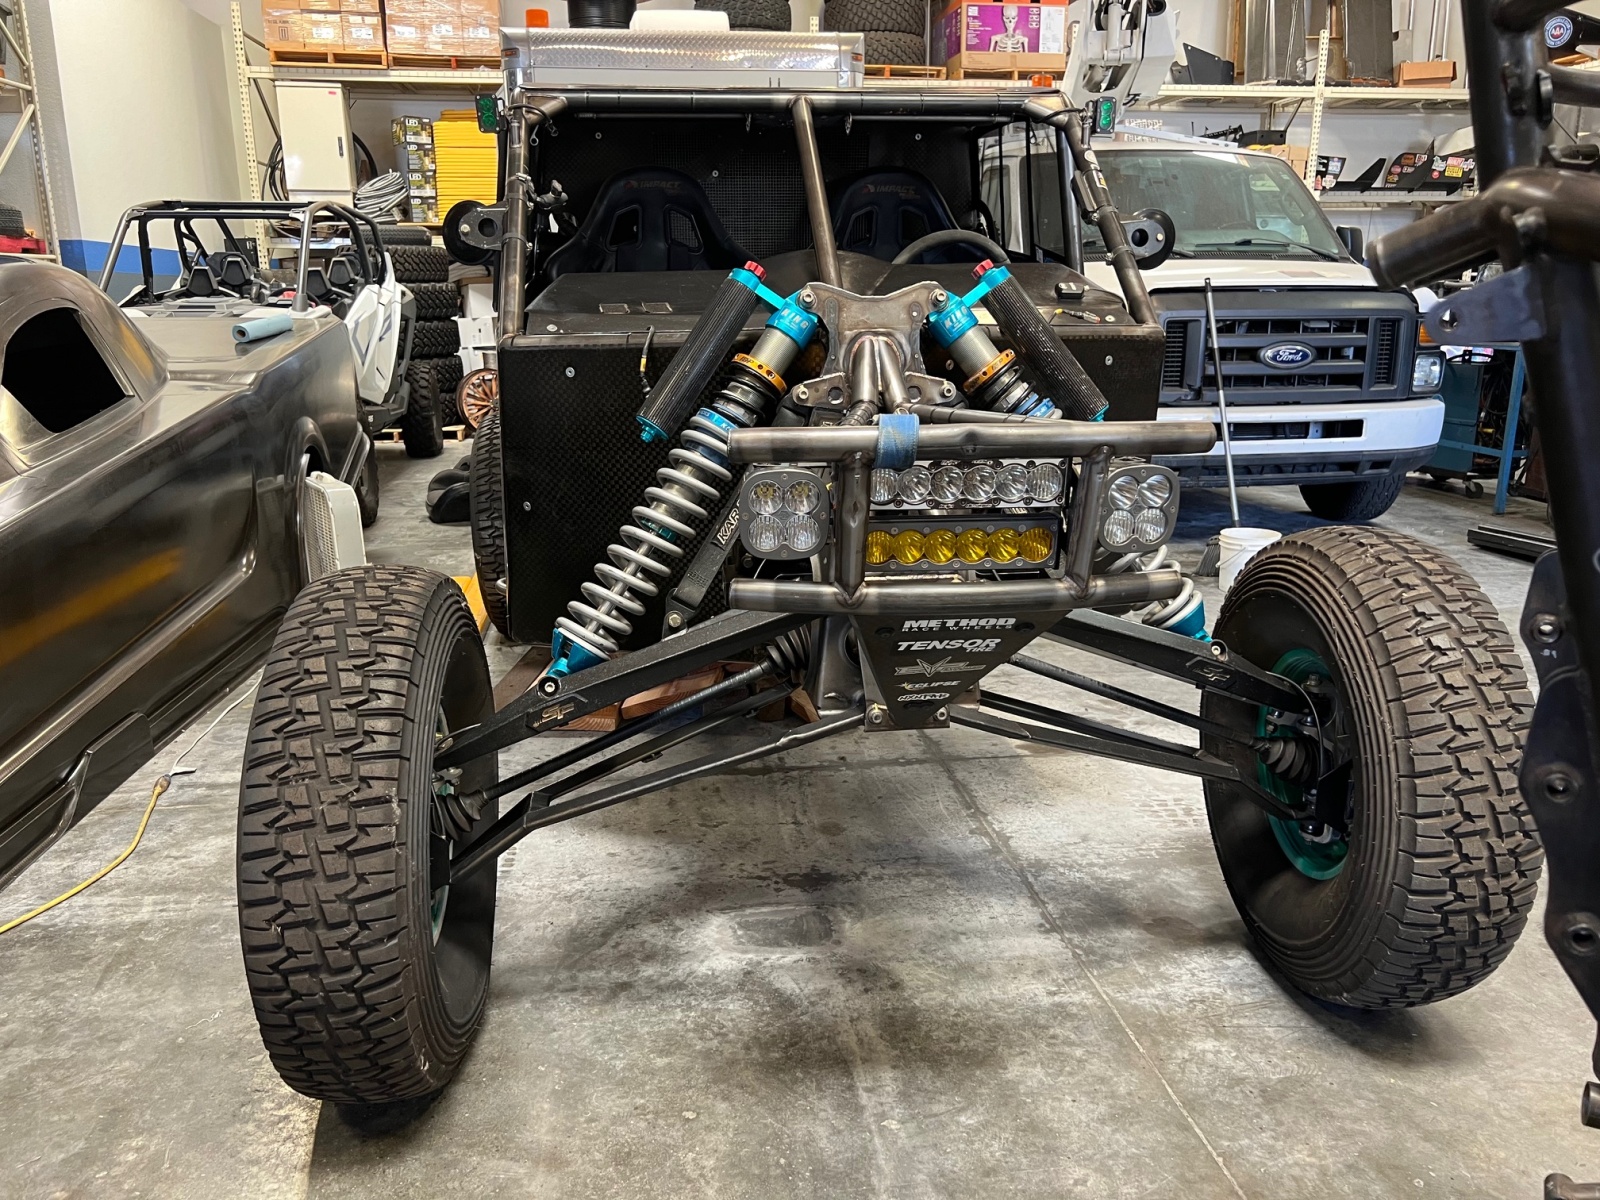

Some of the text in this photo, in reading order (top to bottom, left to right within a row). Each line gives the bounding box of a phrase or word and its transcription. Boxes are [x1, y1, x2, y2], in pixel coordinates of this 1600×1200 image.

[406, 118, 418, 126] LED
[780, 308, 809, 329] KING
[942, 305, 968, 329] KING
[1277, 349, 1302, 361] Ford
[903, 617, 1016, 628] METHOD
[897, 638, 1002, 651] TENSOR
